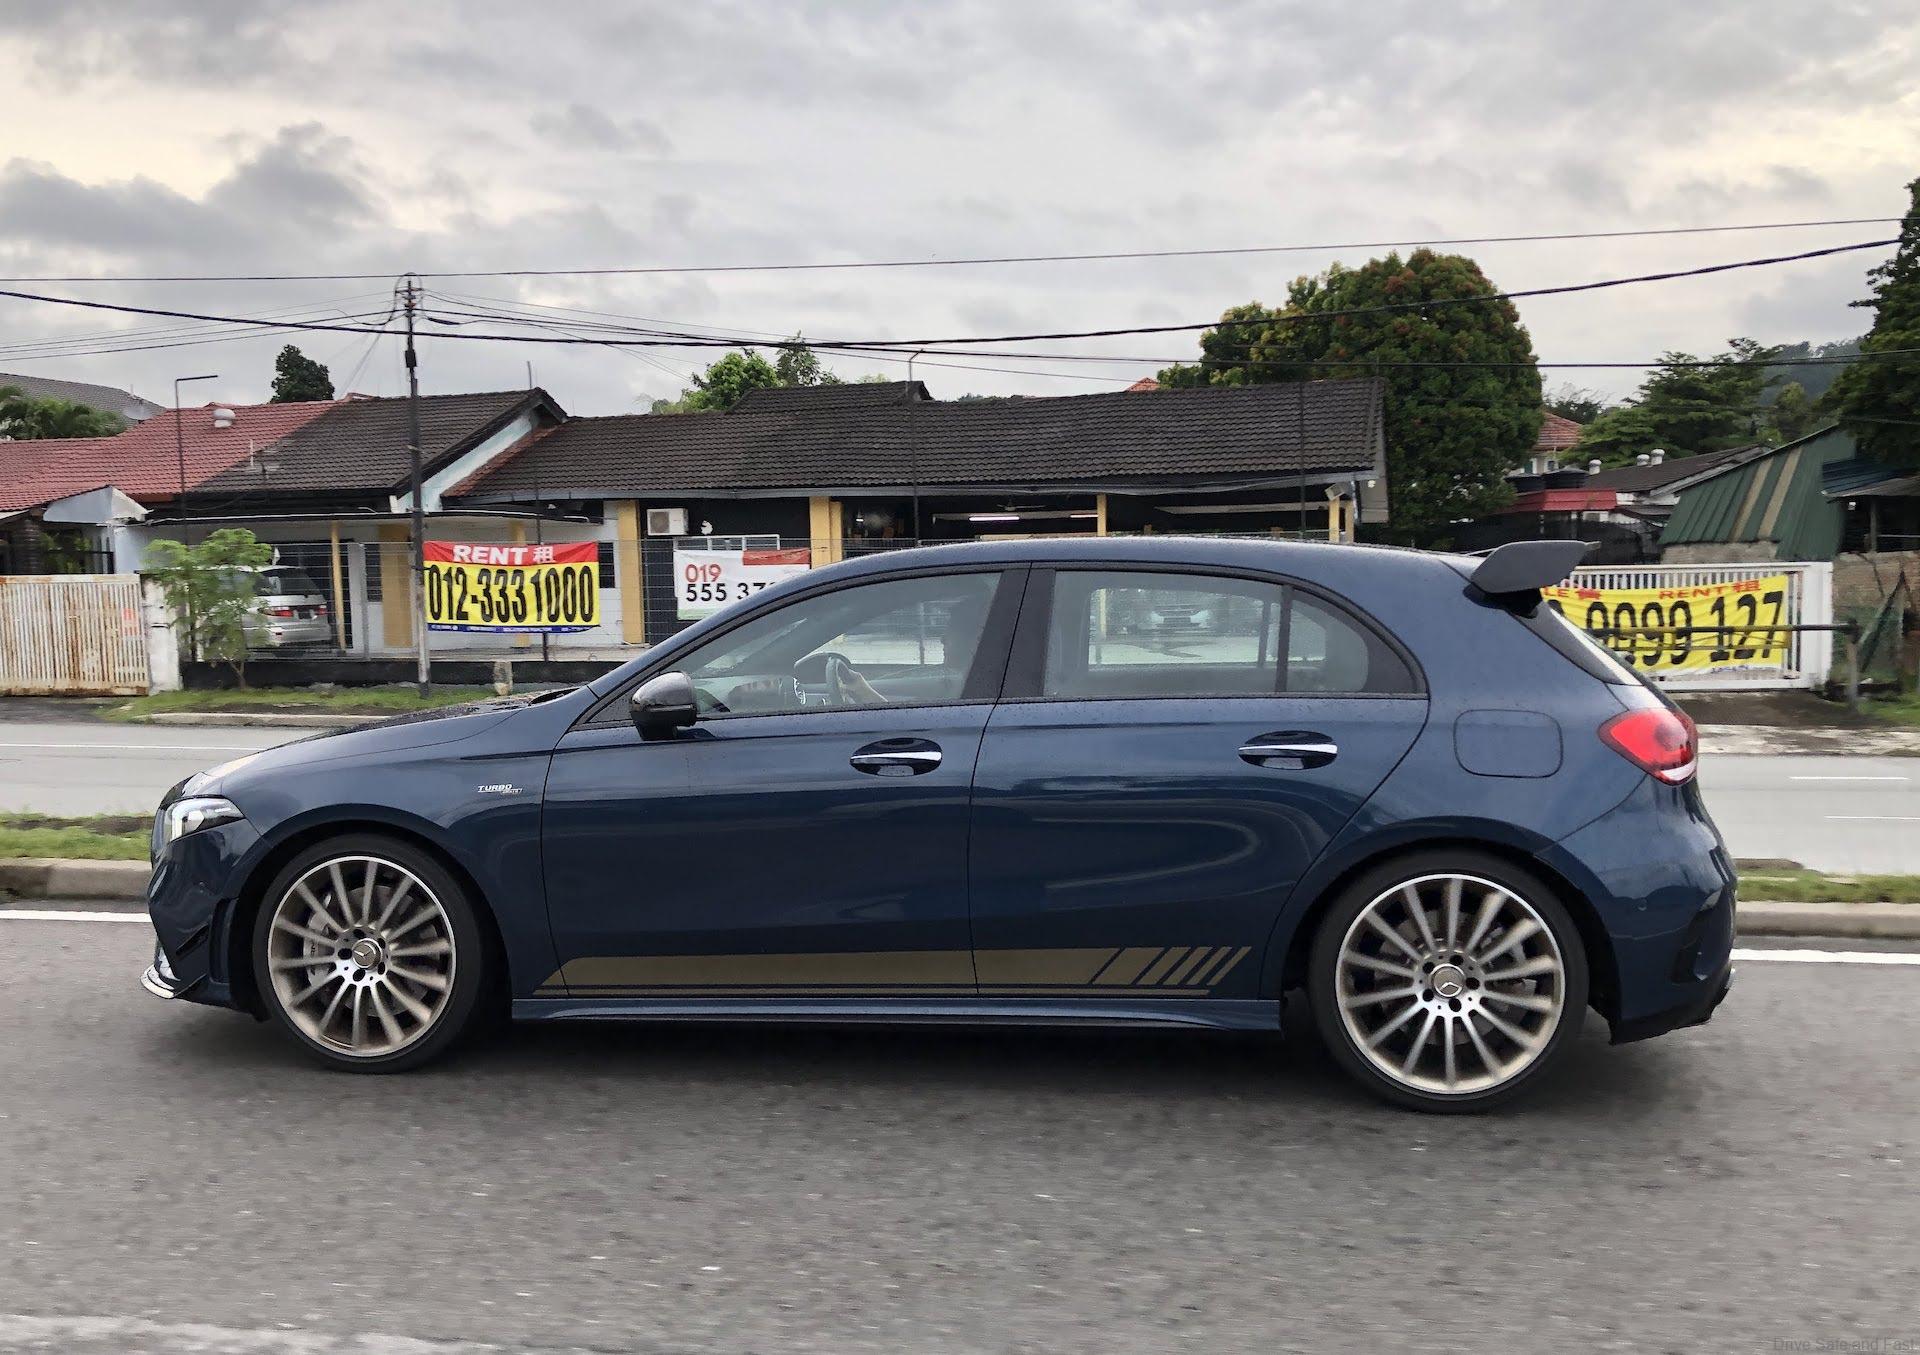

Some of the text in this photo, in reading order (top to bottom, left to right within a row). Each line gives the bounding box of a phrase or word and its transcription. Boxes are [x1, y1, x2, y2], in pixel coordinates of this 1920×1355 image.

[453, 544, 557, 565] RENT 租
[686, 564, 721, 583] 019
[686, 583, 727, 602] 555
[1659, 584, 1729, 600] RENT
[1710, 590, 1784, 663] 127
[478, 783, 513, 792] TURBO
